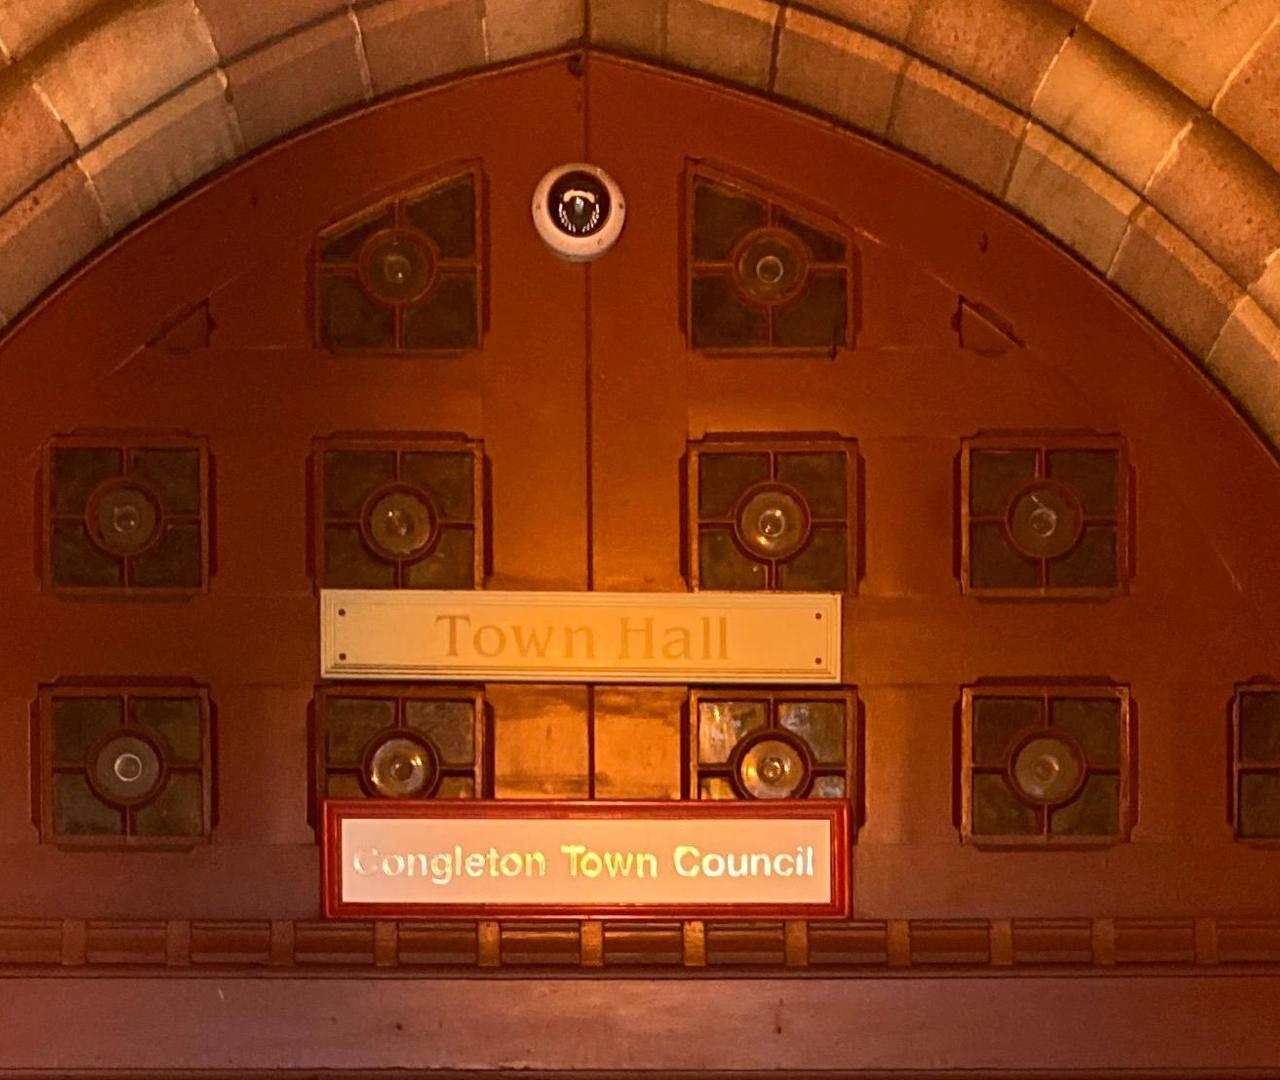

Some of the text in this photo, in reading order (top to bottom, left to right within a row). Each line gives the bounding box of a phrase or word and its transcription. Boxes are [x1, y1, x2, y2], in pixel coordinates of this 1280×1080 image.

[435, 615, 729, 660] Town Hall
[353, 845, 815, 885] Congleton Town Council
